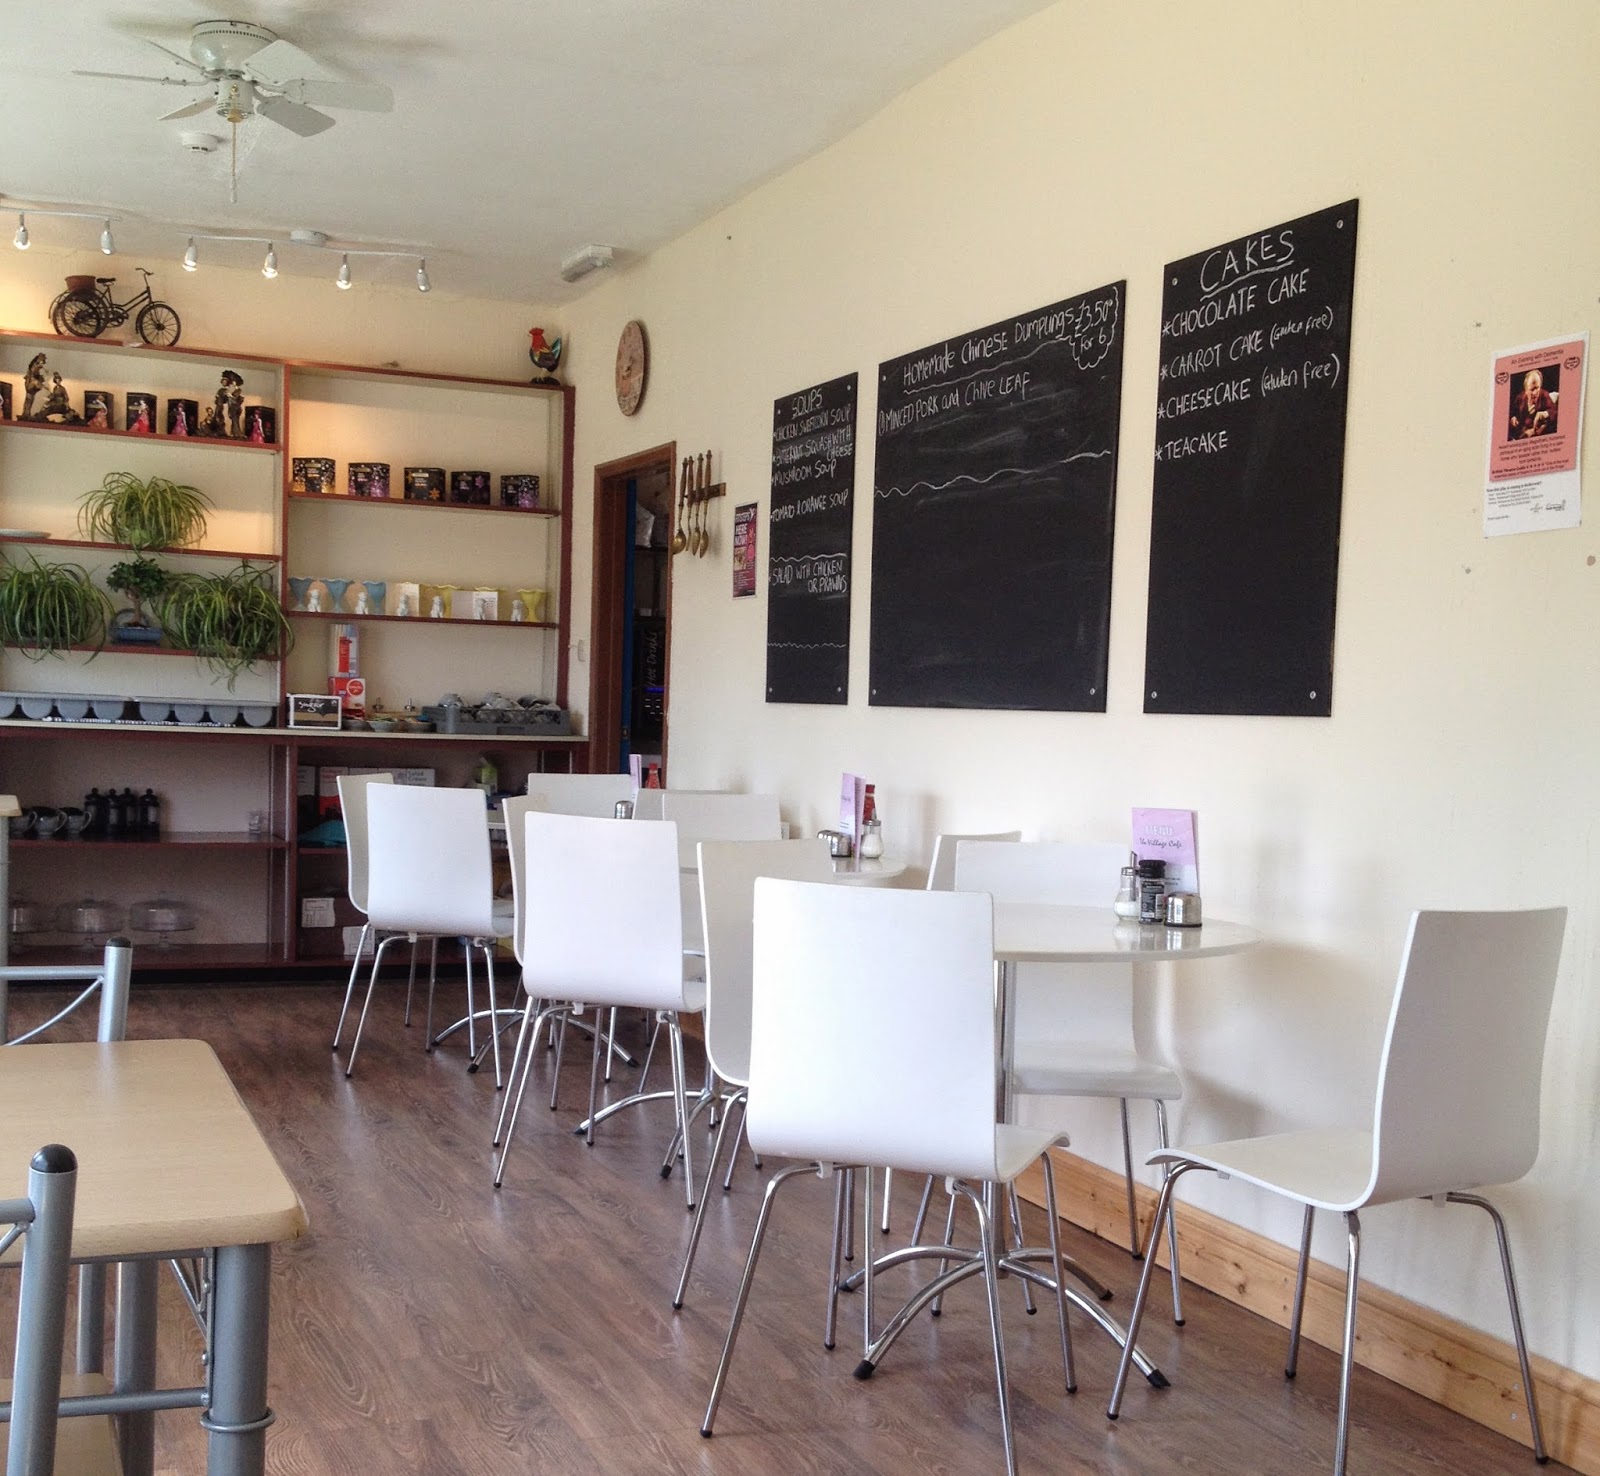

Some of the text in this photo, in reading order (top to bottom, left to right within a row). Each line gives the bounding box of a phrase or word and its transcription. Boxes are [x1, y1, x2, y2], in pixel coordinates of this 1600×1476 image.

[1200, 230, 1294, 292] CAKES
[1172, 268, 1310, 337] CHOCOLATE CAKE
[1099, 326, 1107, 345] 6
[1170, 343, 1222, 379] CARROT
[1229, 330, 1263, 361] CAKE
[792, 388, 823, 419] SOUPS
[916, 395, 939, 422] PORK
[999, 371, 1031, 401] LEAF
[1166, 378, 1251, 419] CHEESECAKE
[1164, 430, 1228, 460] TEACAKE
[829, 488, 849, 508] SOUP
[813, 559, 842, 577] CHICKEN
[808, 577, 818, 593] OR
[1148, 839, 1167, 849] Village
